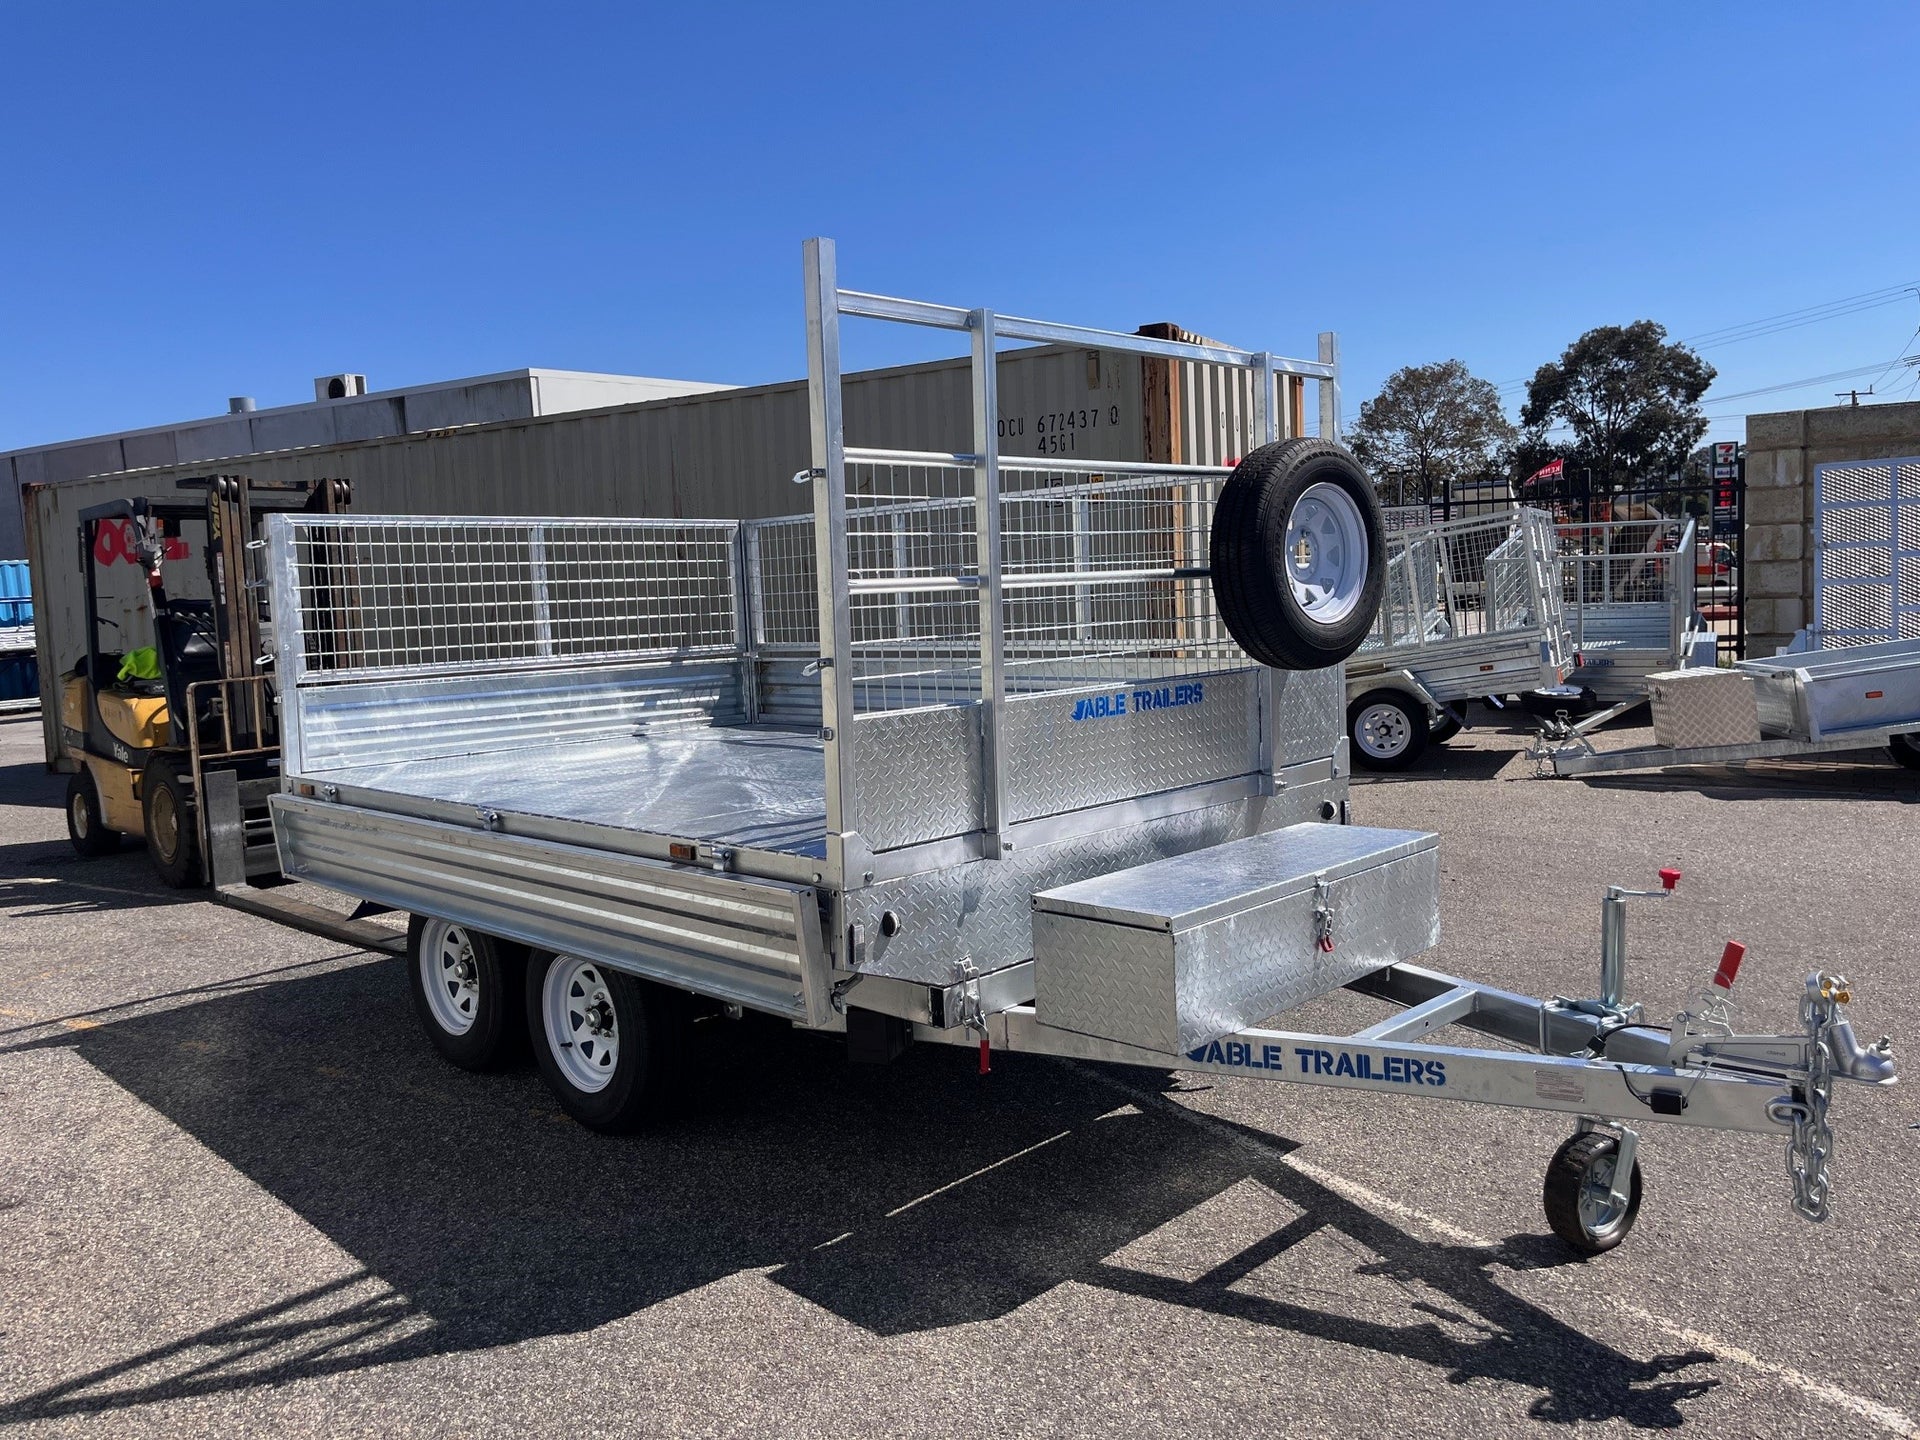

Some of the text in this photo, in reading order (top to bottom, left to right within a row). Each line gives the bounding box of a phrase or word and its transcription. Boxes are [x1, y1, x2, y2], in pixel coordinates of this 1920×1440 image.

[1037, 409, 1099, 434] 672437
[1109, 405, 1119, 426] 0
[1038, 432, 1075, 454] 45G1
[1083, 683, 1203, 720] ABLE TRAILERS
[113, 742, 129, 763] Yale
[1206, 1040, 1446, 1086] ABLE TRAILERS
